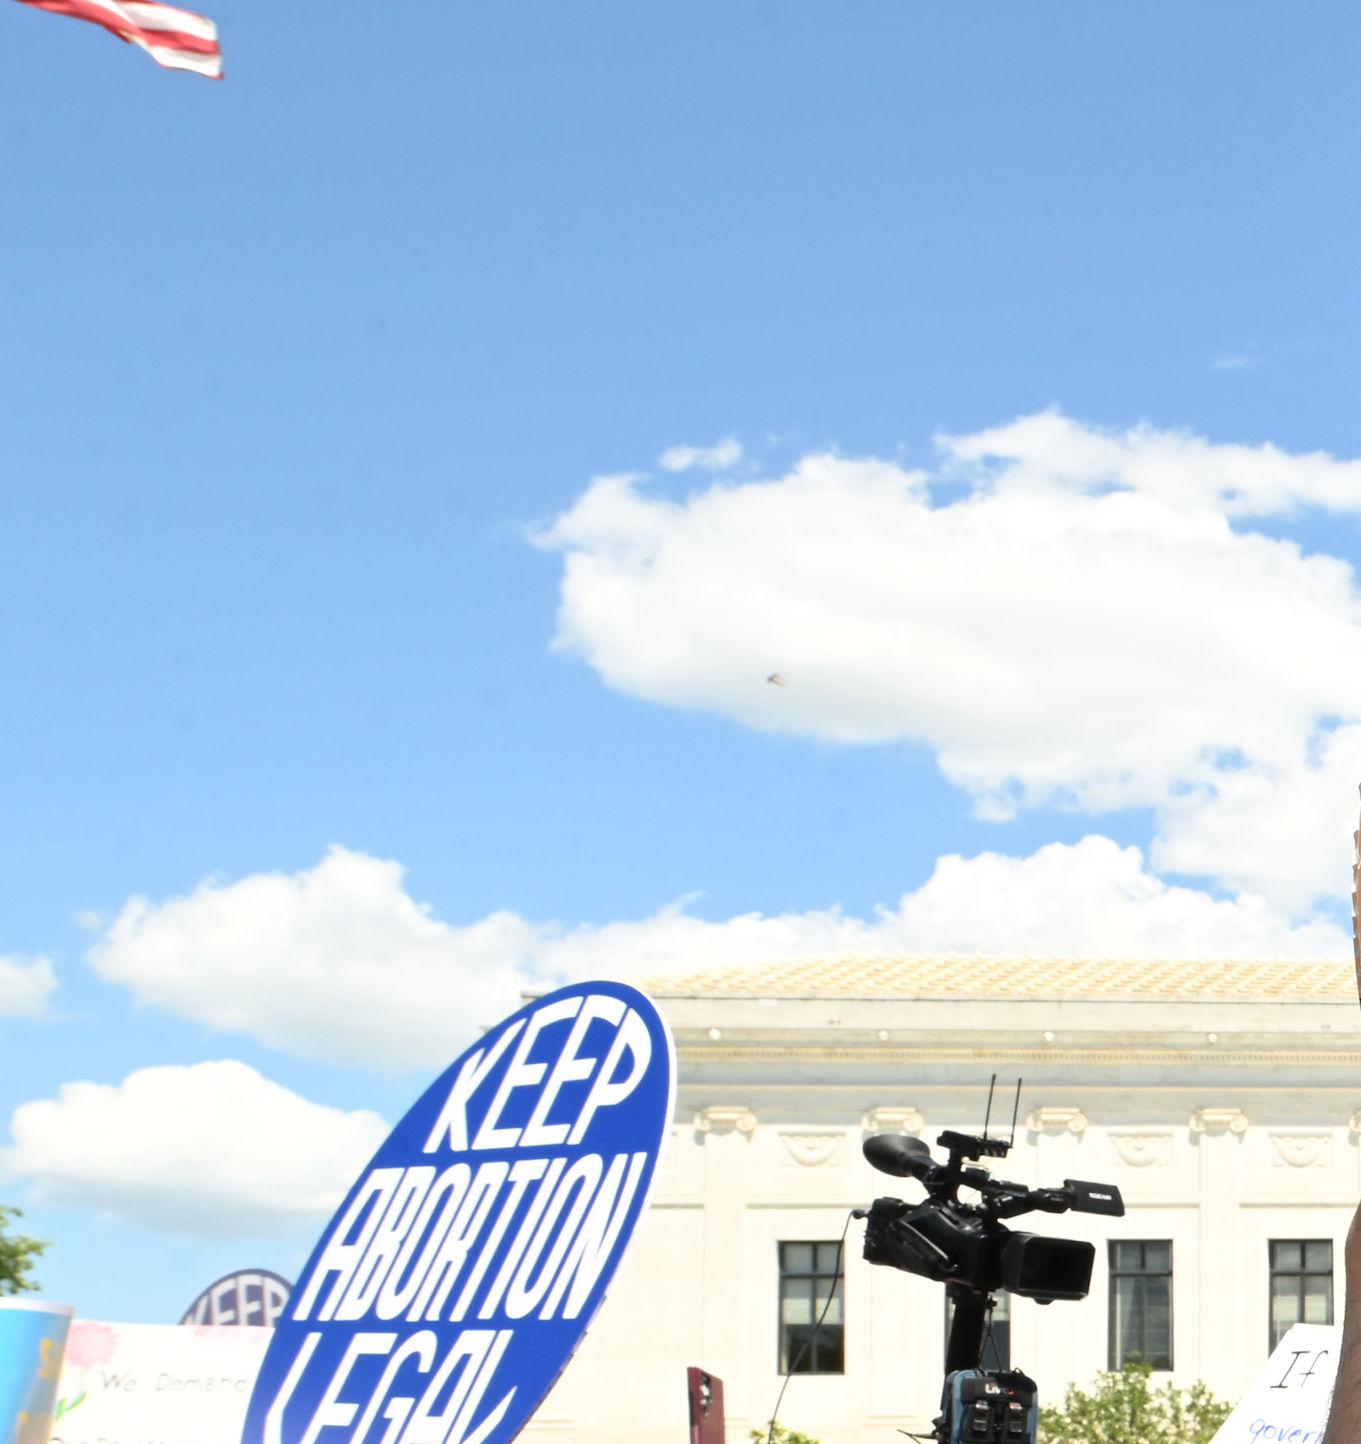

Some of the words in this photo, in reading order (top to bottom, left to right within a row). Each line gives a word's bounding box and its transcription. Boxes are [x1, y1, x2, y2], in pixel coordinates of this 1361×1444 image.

[423, 994, 652, 1154] KEEP
[292, 1152, 647, 1322] ABORTION
[1270, 1350, 1329, 1389] If
